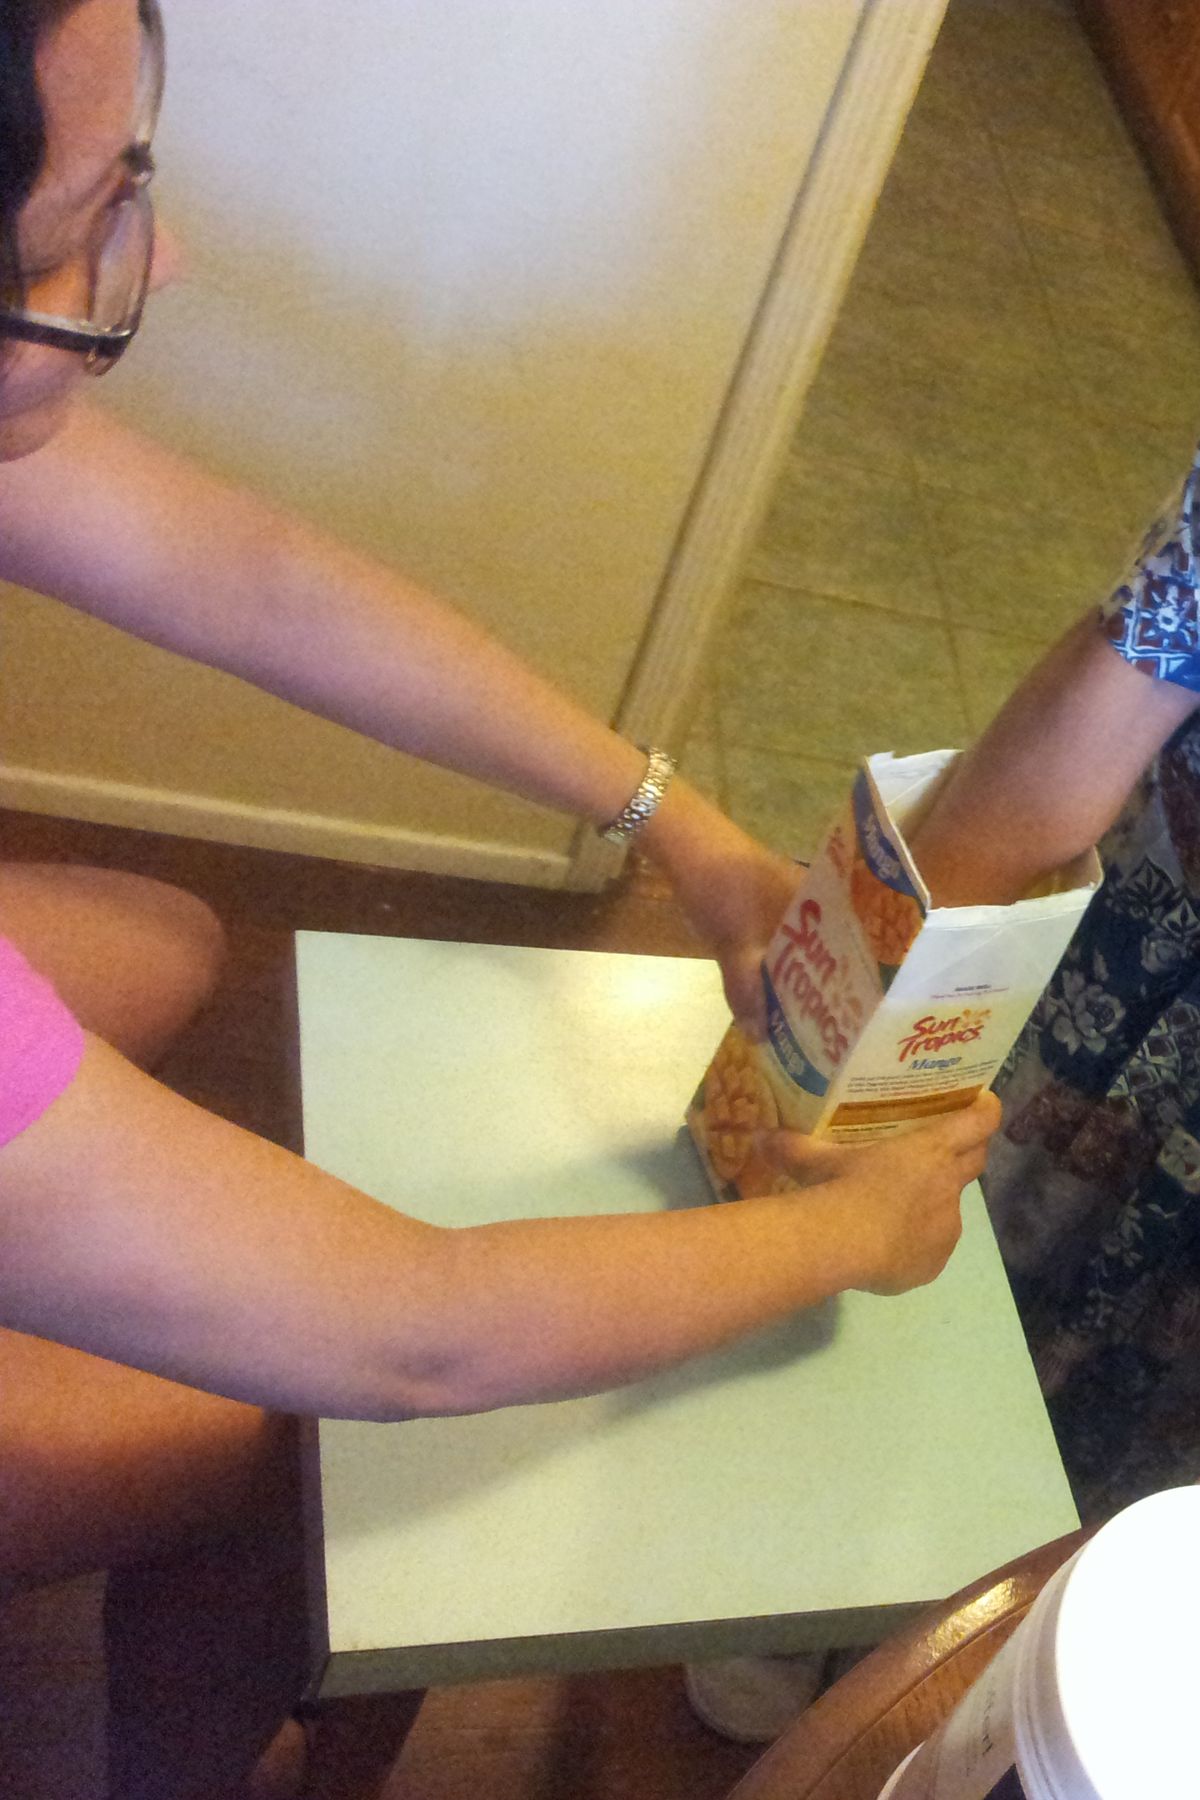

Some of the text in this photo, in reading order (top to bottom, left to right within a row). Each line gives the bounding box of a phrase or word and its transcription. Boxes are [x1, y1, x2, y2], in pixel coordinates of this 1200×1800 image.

[781, 899, 837, 986] Sun
[912, 1015, 961, 1036] Sun
[897, 1024, 985, 1063] Tropics
[909, 1056, 963, 1071] Mango
